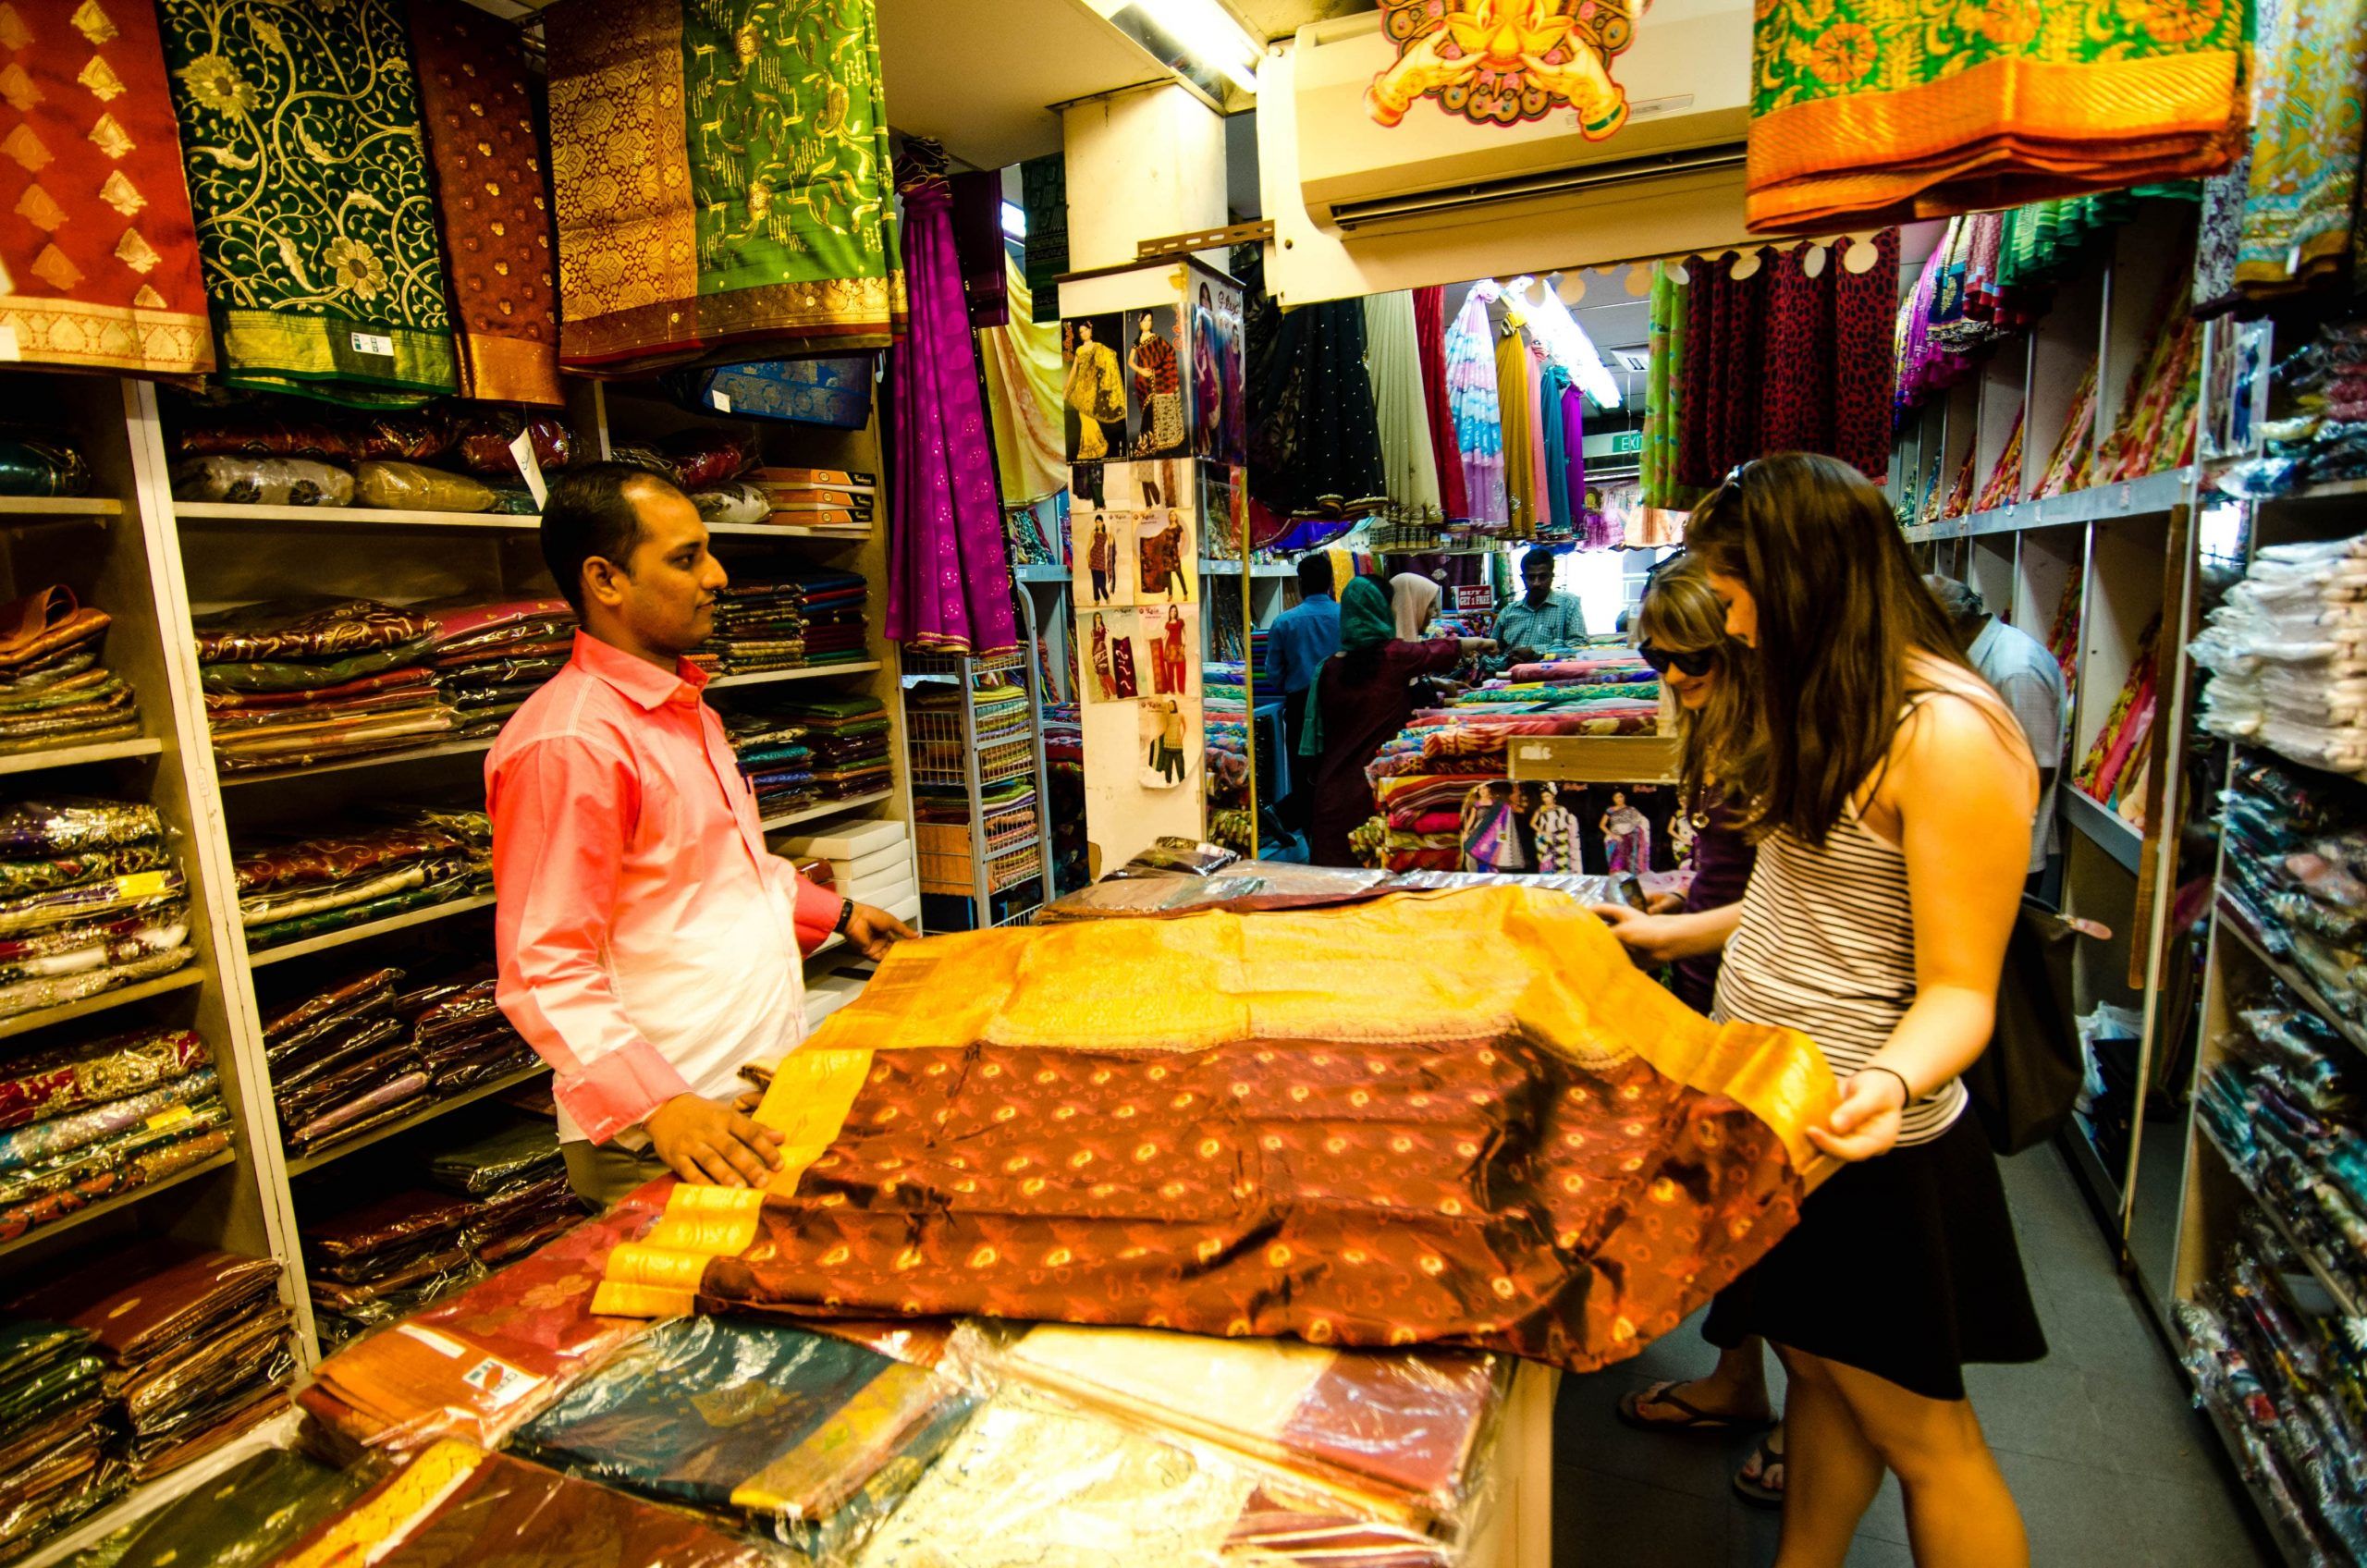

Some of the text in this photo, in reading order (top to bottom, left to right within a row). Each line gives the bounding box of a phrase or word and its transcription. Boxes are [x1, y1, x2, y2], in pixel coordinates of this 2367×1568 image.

[1621, 435, 1643, 451] EXI
[1460, 596, 1470, 606] GET
[1476, 595, 1490, 605] FREE
